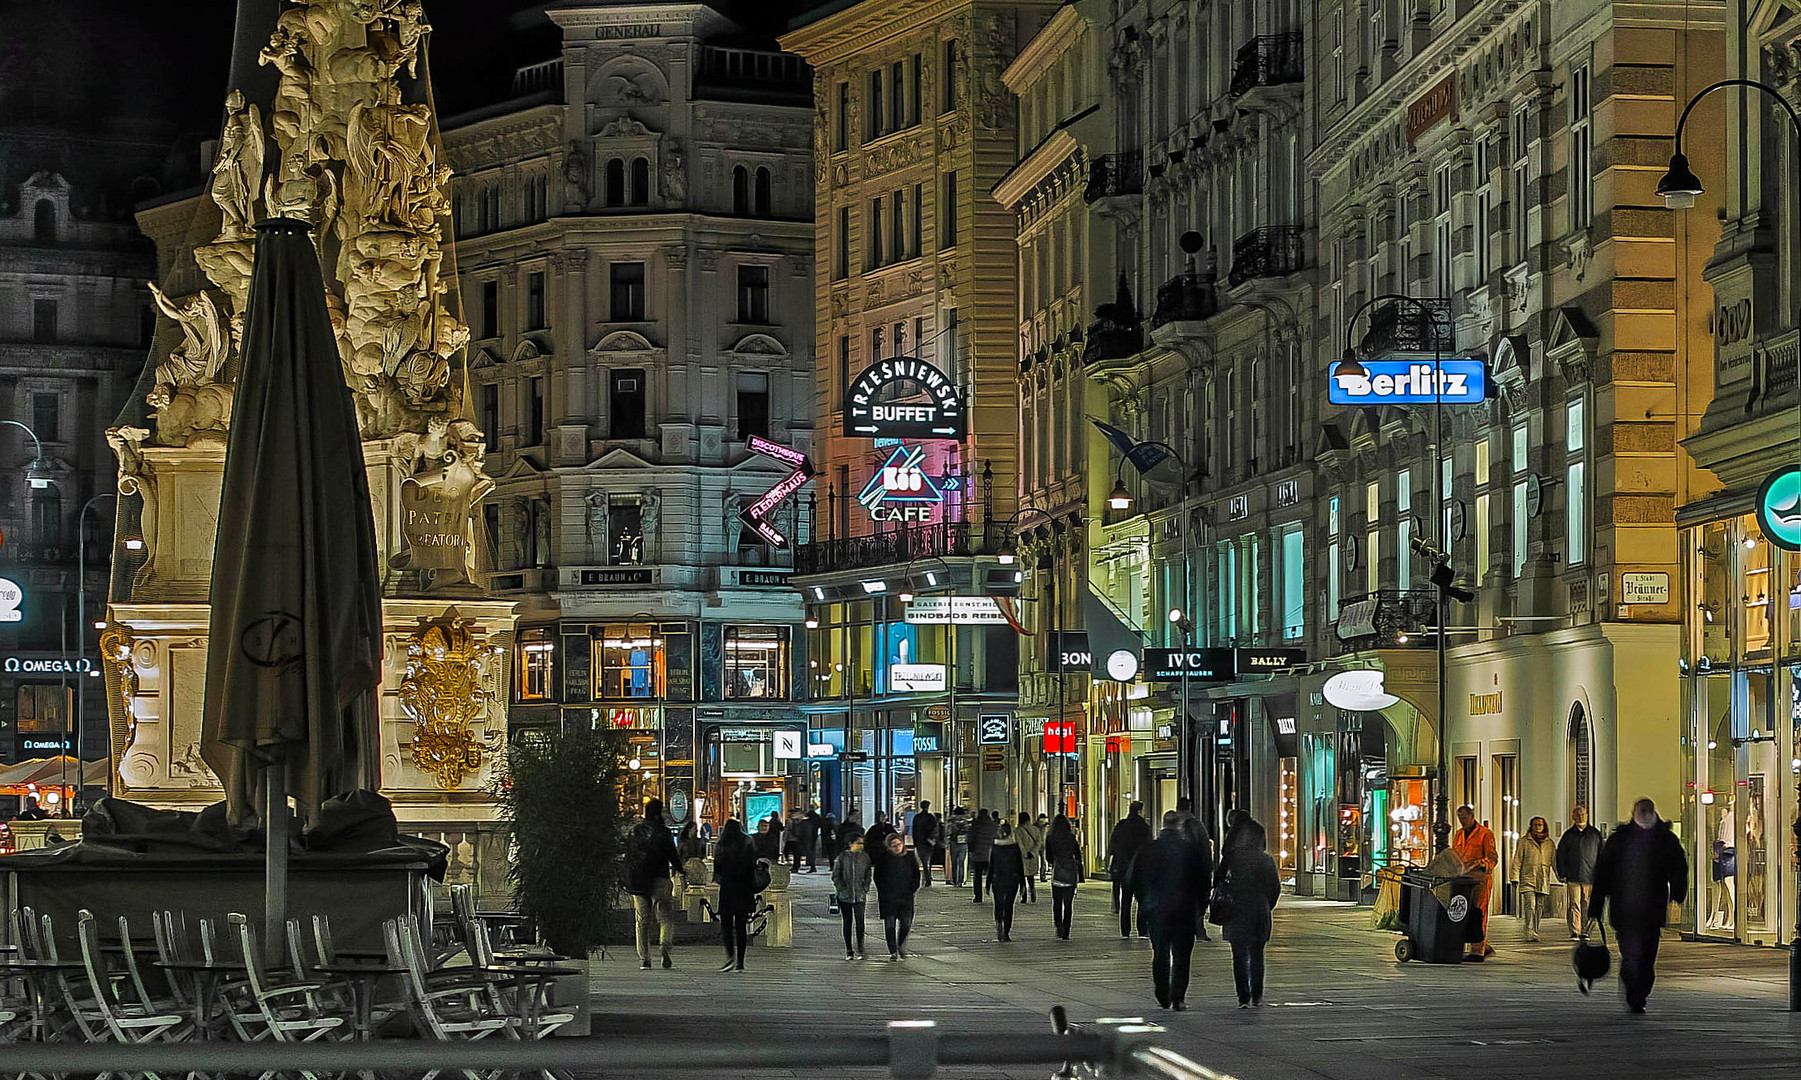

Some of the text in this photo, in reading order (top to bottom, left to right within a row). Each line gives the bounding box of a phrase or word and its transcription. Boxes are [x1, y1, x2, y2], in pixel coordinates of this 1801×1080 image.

[1337, 364, 1468, 396] Berlitz
[872, 406, 937, 421] BUFFET
[751, 438, 805, 462] DISCOTHEQUE
[750, 473, 807, 520] FLEDERMAUS
[871, 507, 932, 521] CAFE
[760, 522, 775, 537] BAR
[598, 573, 626, 582] BRAUN
[754, 574, 780, 584] BRAUN
[22, 660, 72, 672] OMEGA
[1168, 653, 1202, 668] IWC
[1251, 656, 1288, 665] BALLY
[33, 741, 61, 749] OMEGA
[913, 737, 938, 751] FOSSIL
